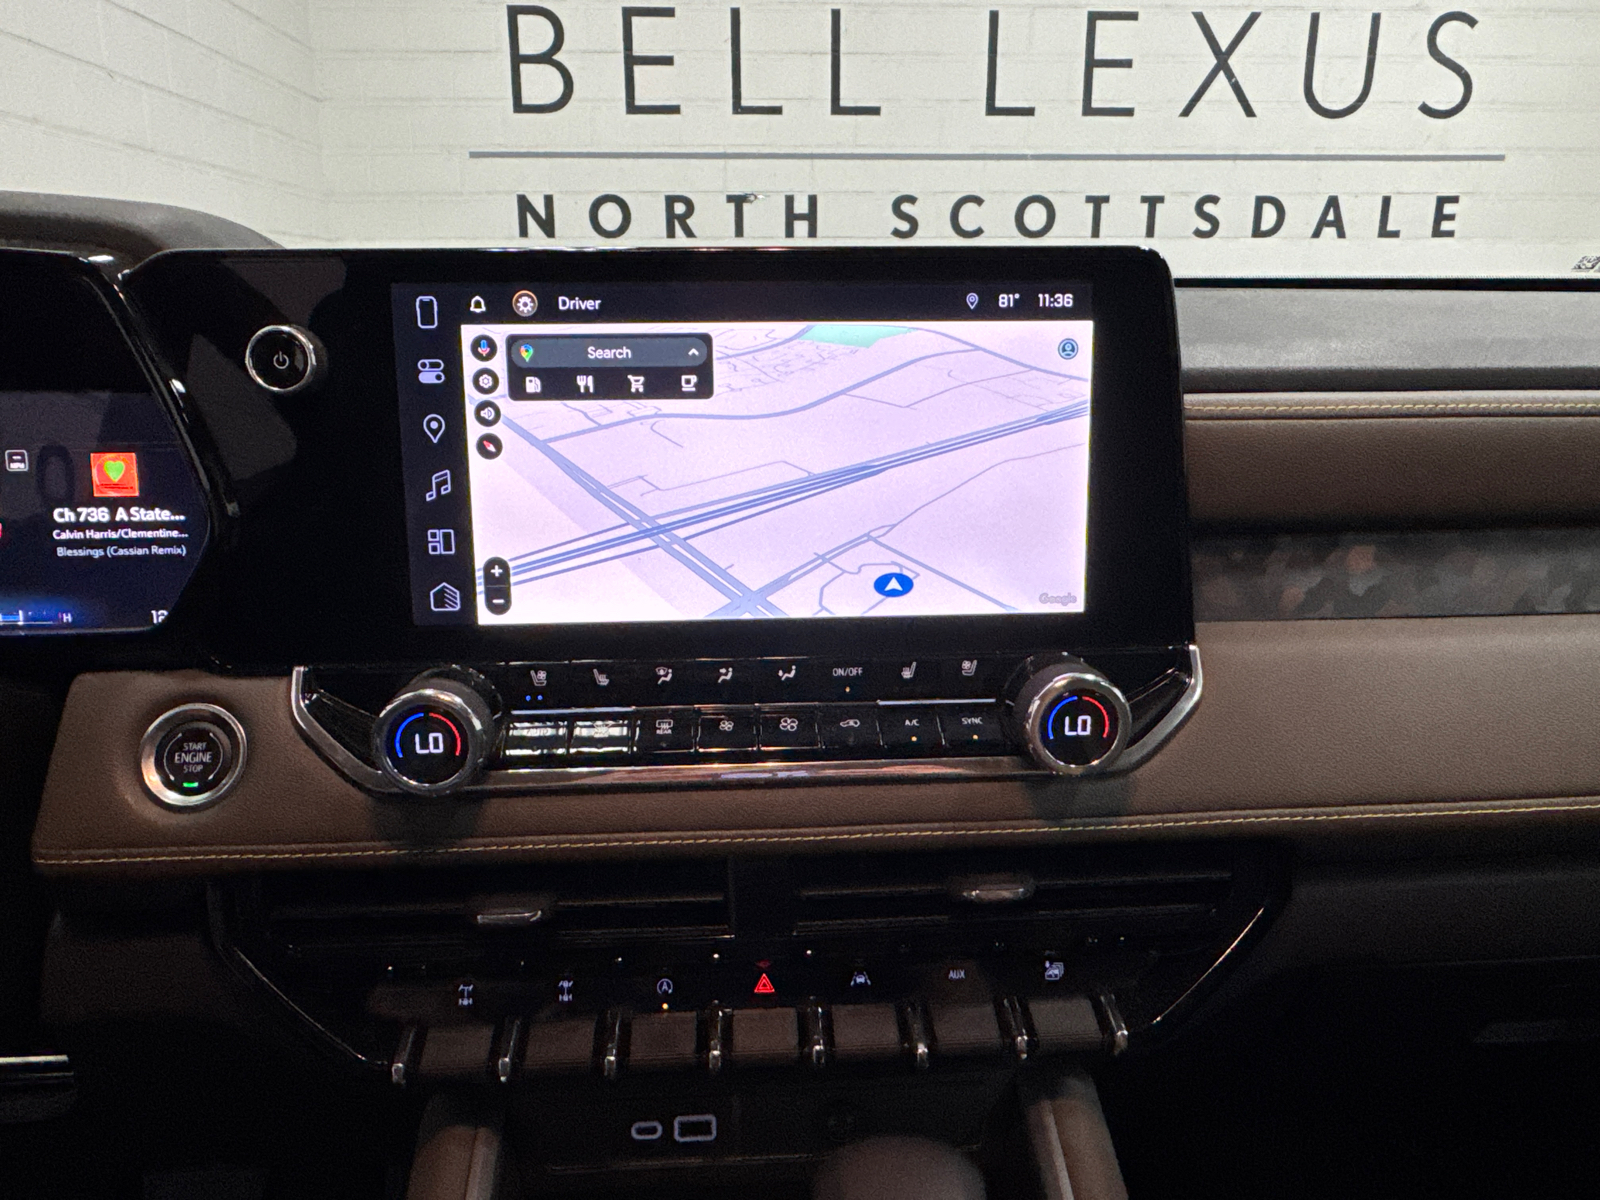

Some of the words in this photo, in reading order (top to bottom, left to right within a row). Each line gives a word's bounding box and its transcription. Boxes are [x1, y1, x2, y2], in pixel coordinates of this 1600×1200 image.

[507, 4, 882, 116] BELL
[985, 10, 1478, 119] LEXUS
[517, 193, 818, 239] NORTH
[890, 194, 1460, 239] SCOTTSDALE
[558, 296, 601, 311] Driver
[998, 293, 1020, 308] 81°
[1038, 293, 1074, 308] 11:36
[587, 346, 632, 360] Search
[53, 507, 76, 522] Ch
[77, 507, 110, 522] 736
[115, 507, 128, 521] A
[52, 530, 84, 540] Calvin
[56, 546, 105, 558] Blessings
[106, 546, 149, 557] (Cassian
[151, 545, 187, 556] Remix)
[832, 667, 863, 677] ON/OFF
[961, 717, 983, 725] SYNC
[1064, 715, 1091, 736] LO
[183, 742, 206, 751] START
[415, 732, 444, 754] LO
[174, 751, 213, 763] ENGINE
[183, 764, 203, 773] STOP
[948, 969, 965, 979] AUX
